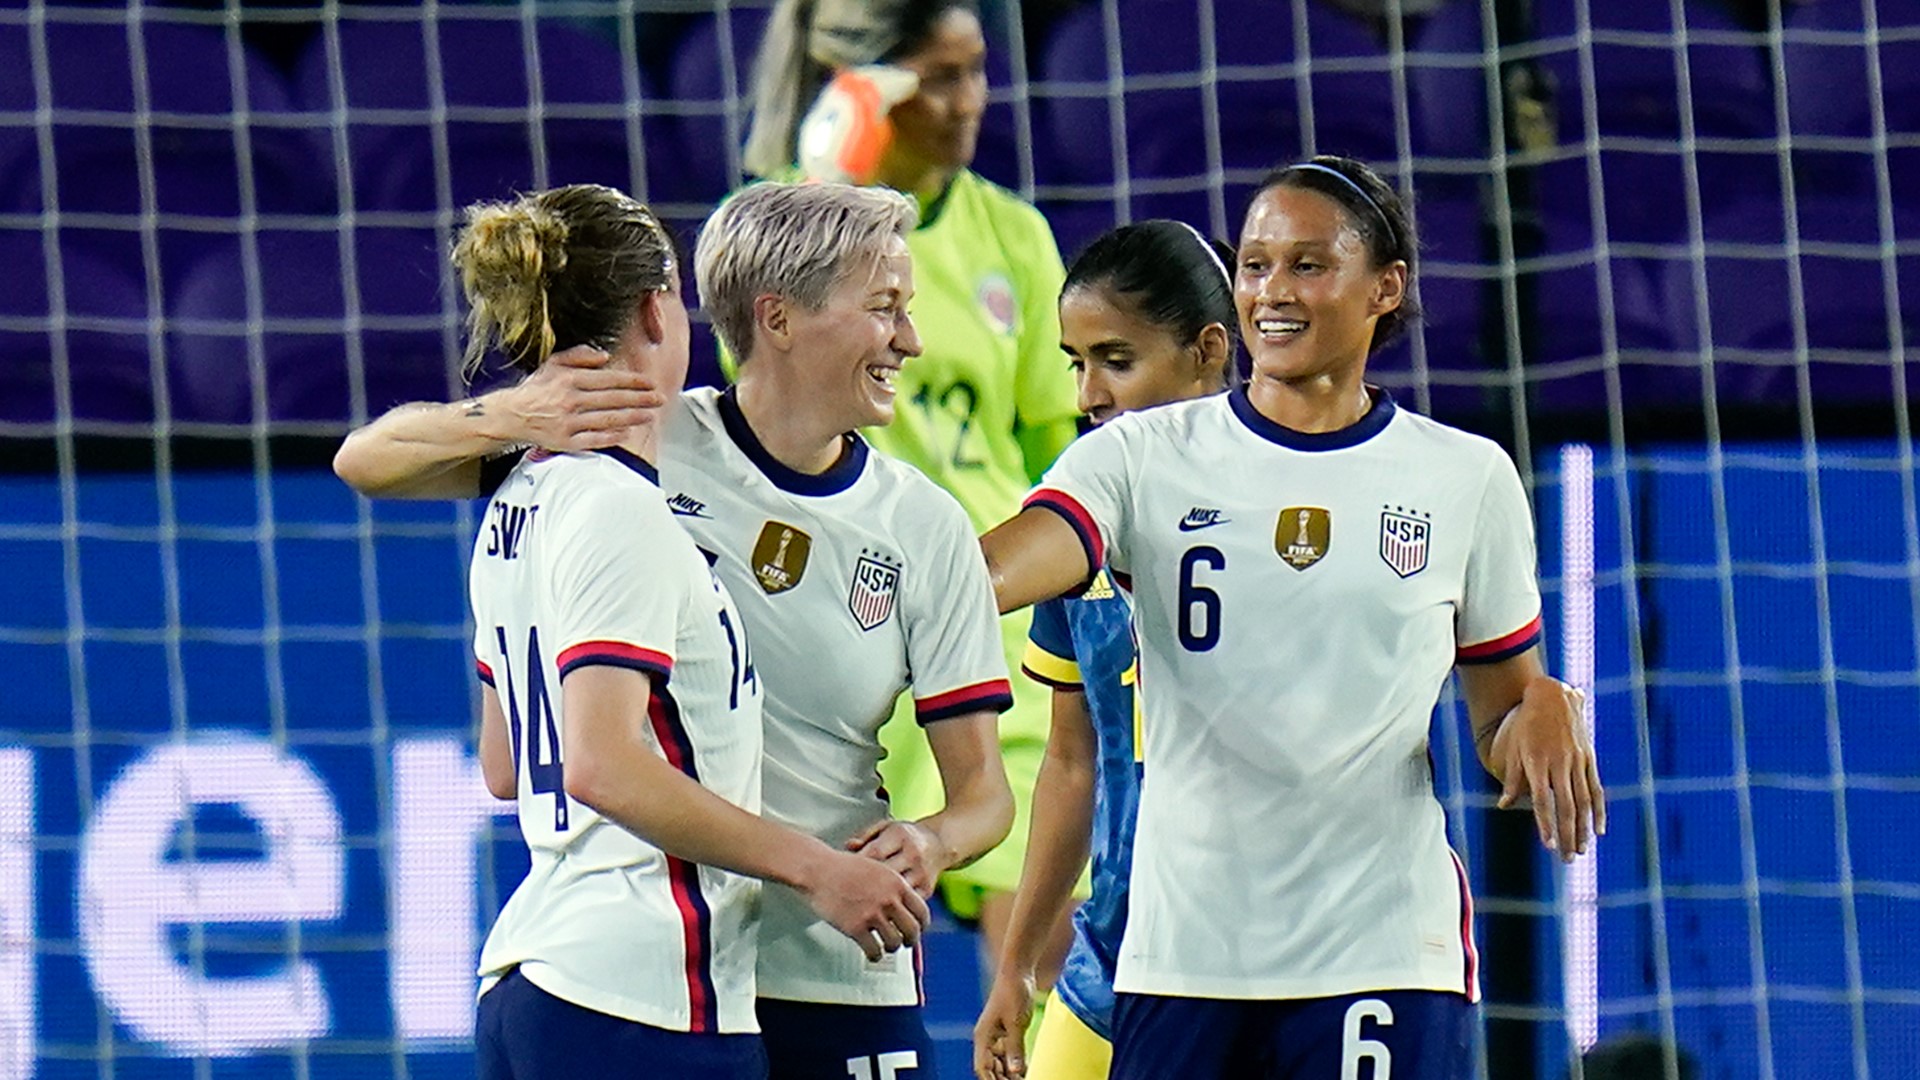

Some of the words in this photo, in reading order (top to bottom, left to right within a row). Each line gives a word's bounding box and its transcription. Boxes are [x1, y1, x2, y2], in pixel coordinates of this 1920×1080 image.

[912, 381, 985, 470] 12
[671, 493, 706, 513] NIKE
[1187, 507, 1221, 522] NIKE
[1386, 518, 1425, 542] USA
[1288, 545, 1315, 556] FIFA
[762, 563, 788, 583] FIFA
[860, 564, 895, 592] USA
[1178, 546, 1225, 653] 6
[718, 608, 756, 710] 14
[496, 626, 568, 832] 14
[1341, 999, 1393, 1080] 6
